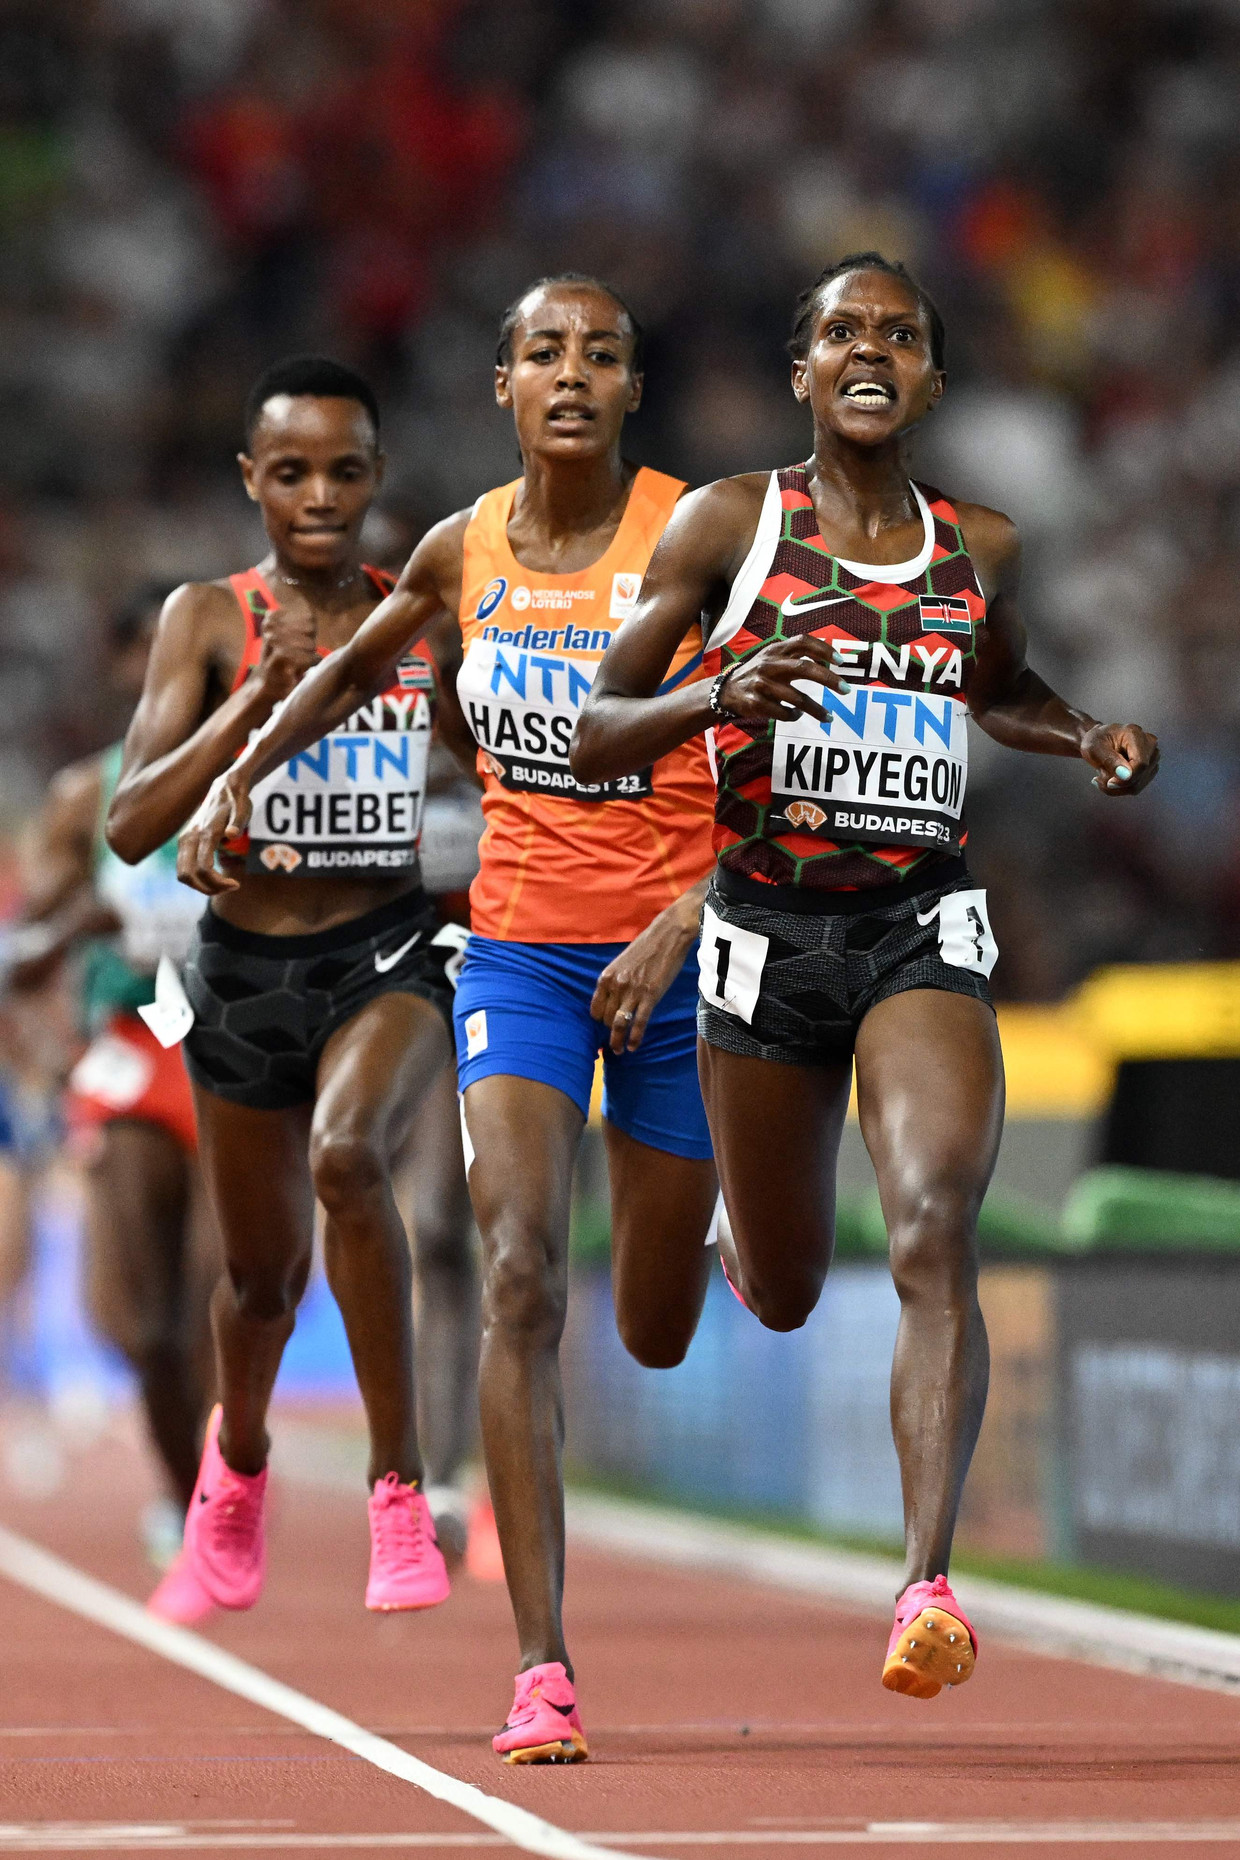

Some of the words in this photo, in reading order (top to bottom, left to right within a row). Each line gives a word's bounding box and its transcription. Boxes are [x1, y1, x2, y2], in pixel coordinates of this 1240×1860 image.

[531, 590, 596, 600] NEDERLANDSE
[531, 600, 572, 609] LOTERIJ
[817, 638, 963, 688] ENYA
[338, 693, 430, 731] NYA
[469, 702, 572, 758] HASS
[819, 686, 952, 751] NTN
[288, 736, 409, 783] NTN
[784, 743, 962, 810] KIPYEGON
[616, 775, 638, 792] 23
[265, 791, 419, 835] CHEBET
[834, 811, 940, 837] BUDAPES
[714, 936, 732, 999] 1
